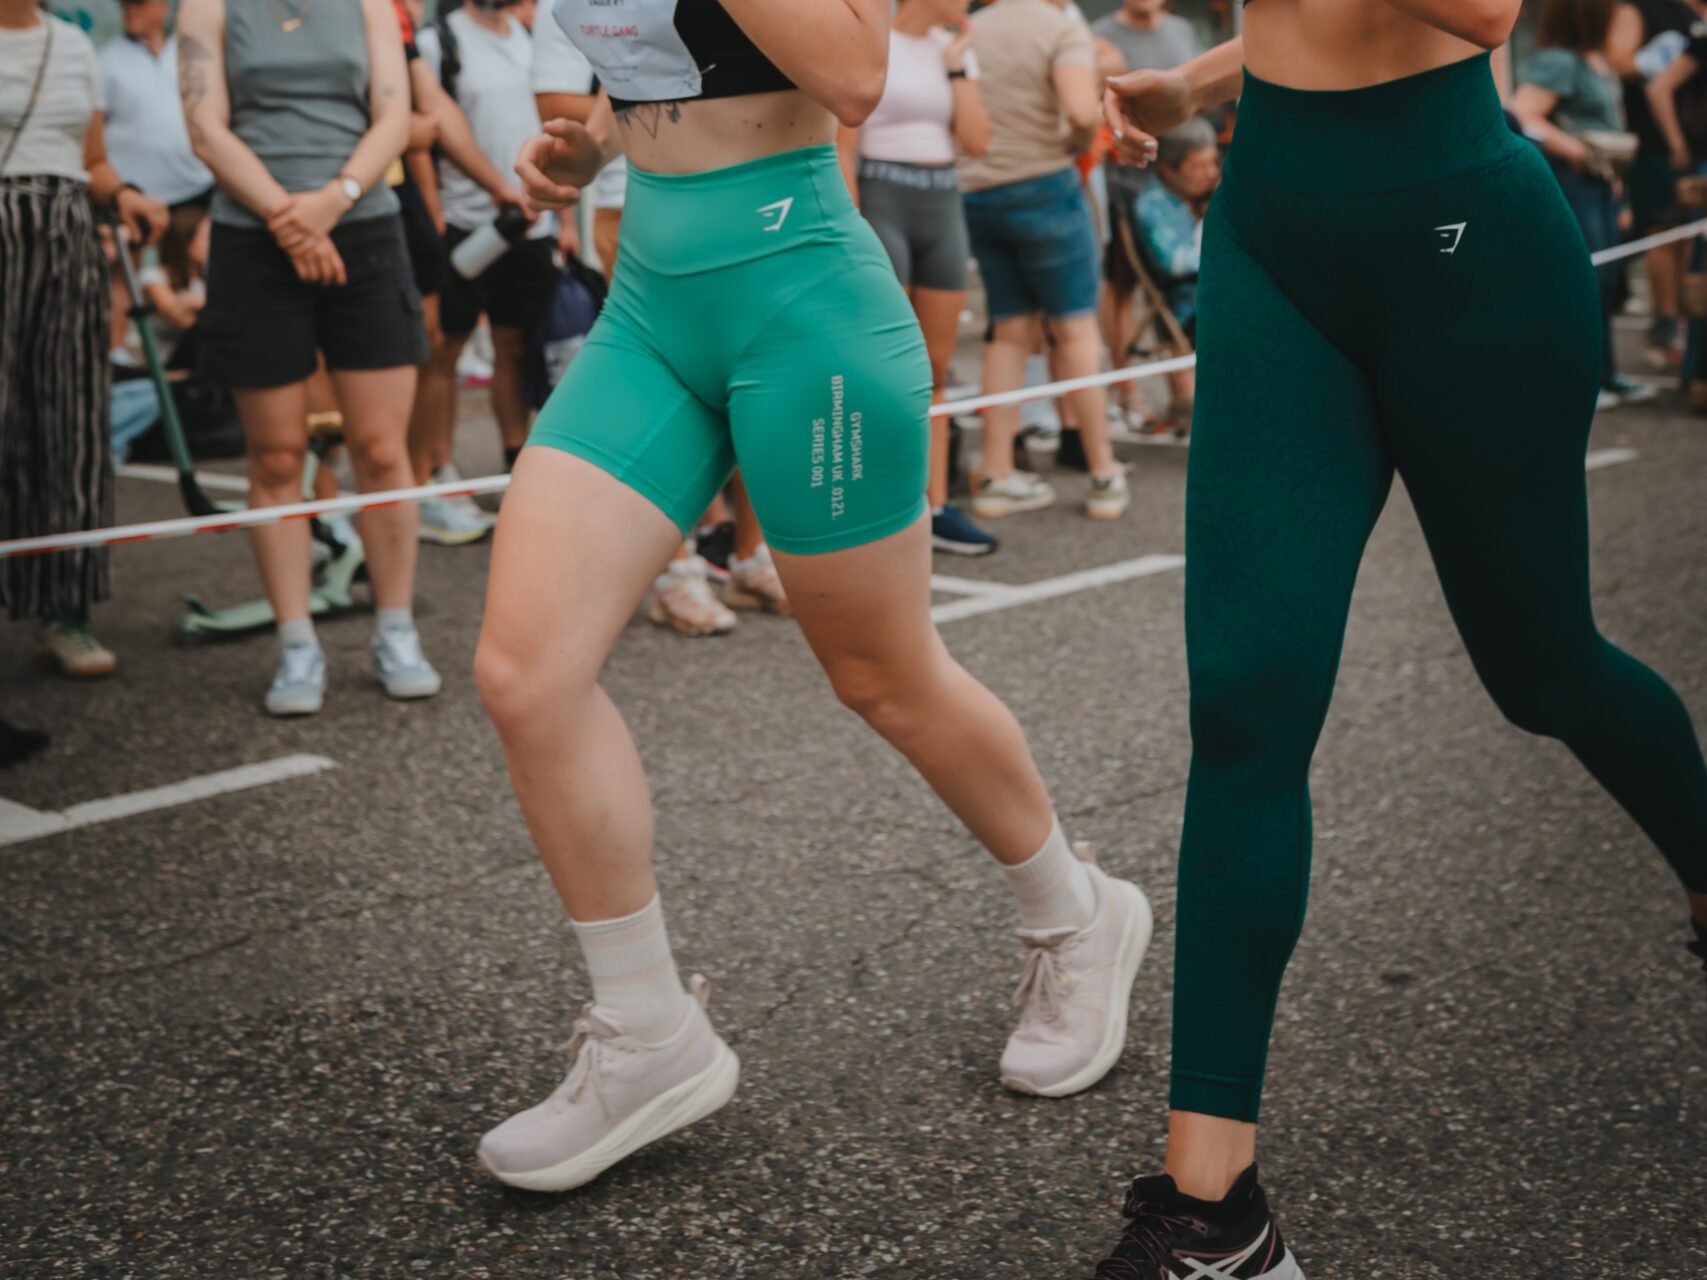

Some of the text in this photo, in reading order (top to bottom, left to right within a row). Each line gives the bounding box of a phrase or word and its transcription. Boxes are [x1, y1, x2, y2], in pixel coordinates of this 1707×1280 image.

[579, 24, 639, 37] TURTLE GANG
[811, 418, 825, 488] SERIES 001
[831, 374, 844, 464] BIRMINGHAM
[850, 411, 863, 481] GYMSHARK
[831, 465, 844, 482] UK
